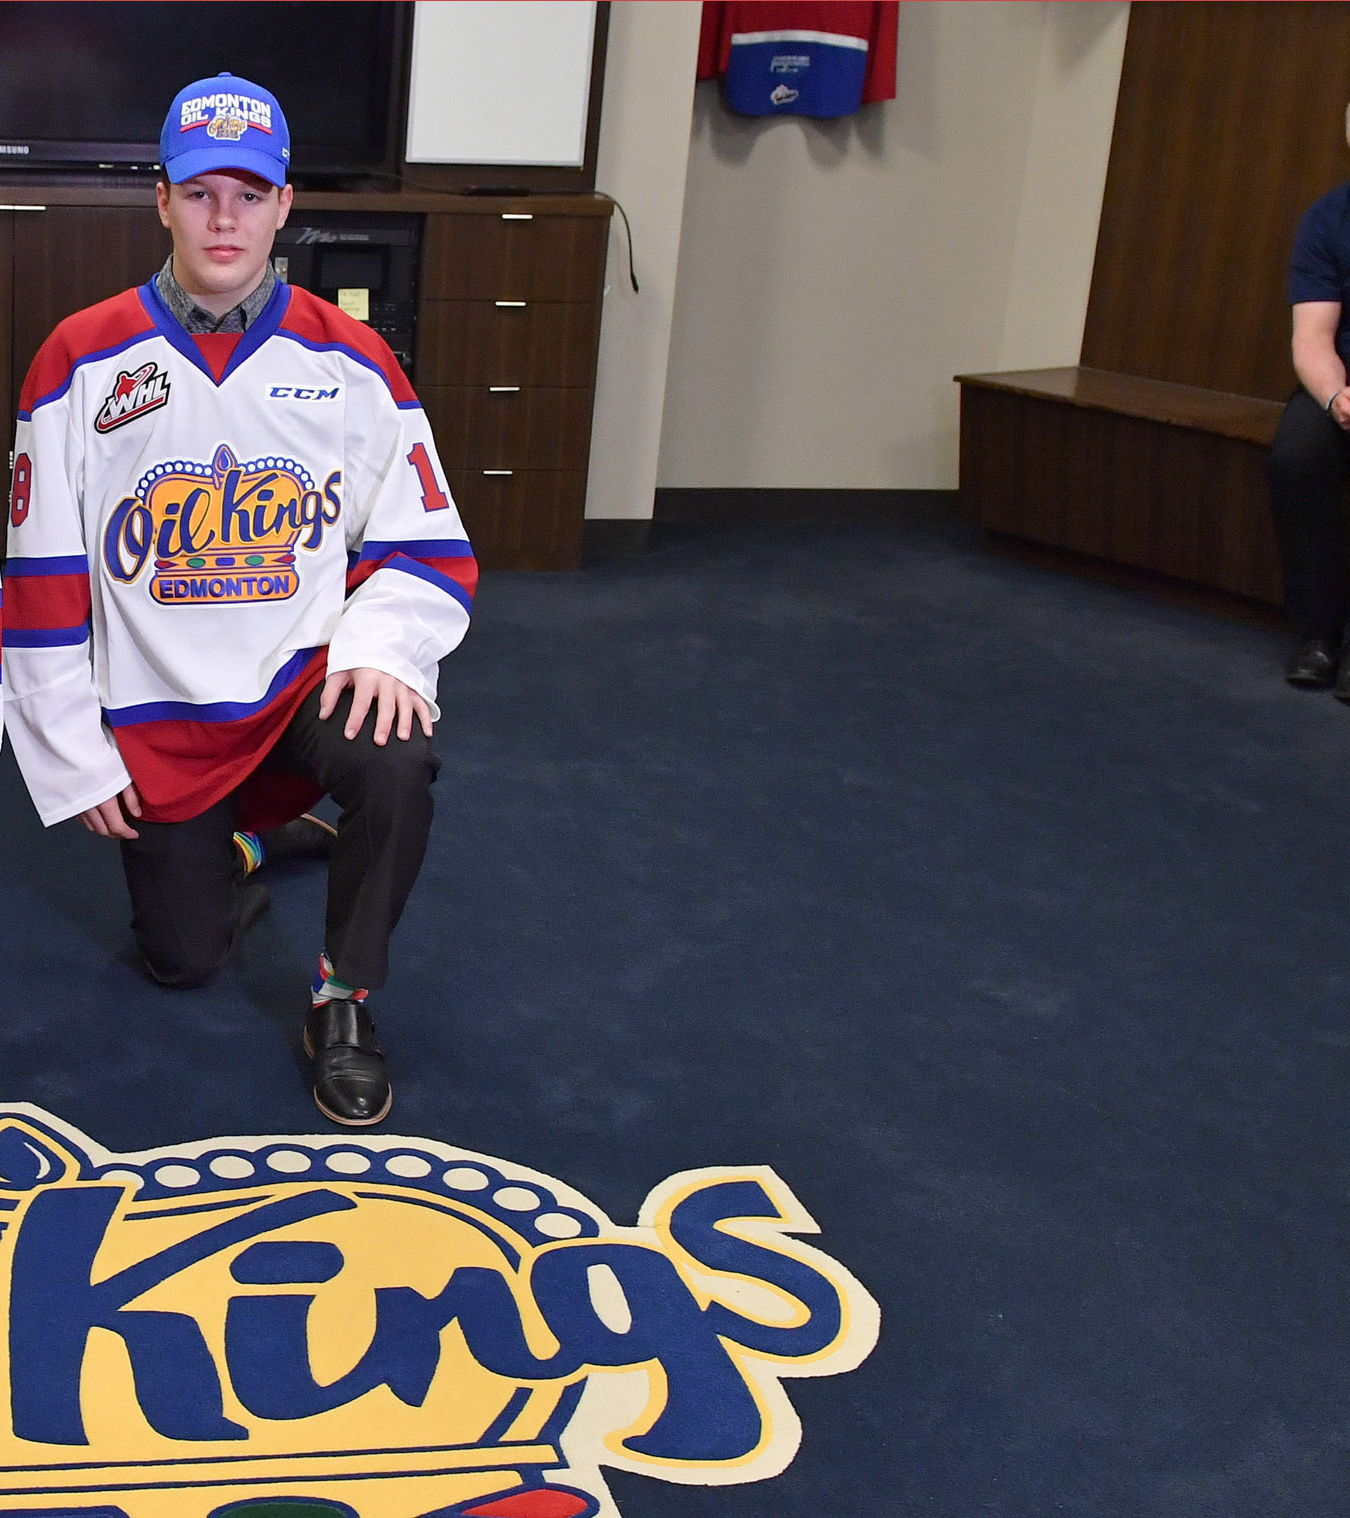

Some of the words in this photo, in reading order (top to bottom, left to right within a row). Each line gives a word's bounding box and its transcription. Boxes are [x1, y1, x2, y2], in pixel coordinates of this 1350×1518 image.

[180, 110, 209, 126] OIL
[215, 107, 272, 128] KINGS
[181, 93, 271, 119] EDMONTON
[107, 375, 167, 419] WHL
[269, 386, 340, 401] CCM
[406, 442, 450, 513] 1
[103, 487, 216, 585] Oil
[220, 469, 343, 553] Kings
[159, 575, 290, 599] EDMONTON
[7, 1178, 844, 1462] Kings
